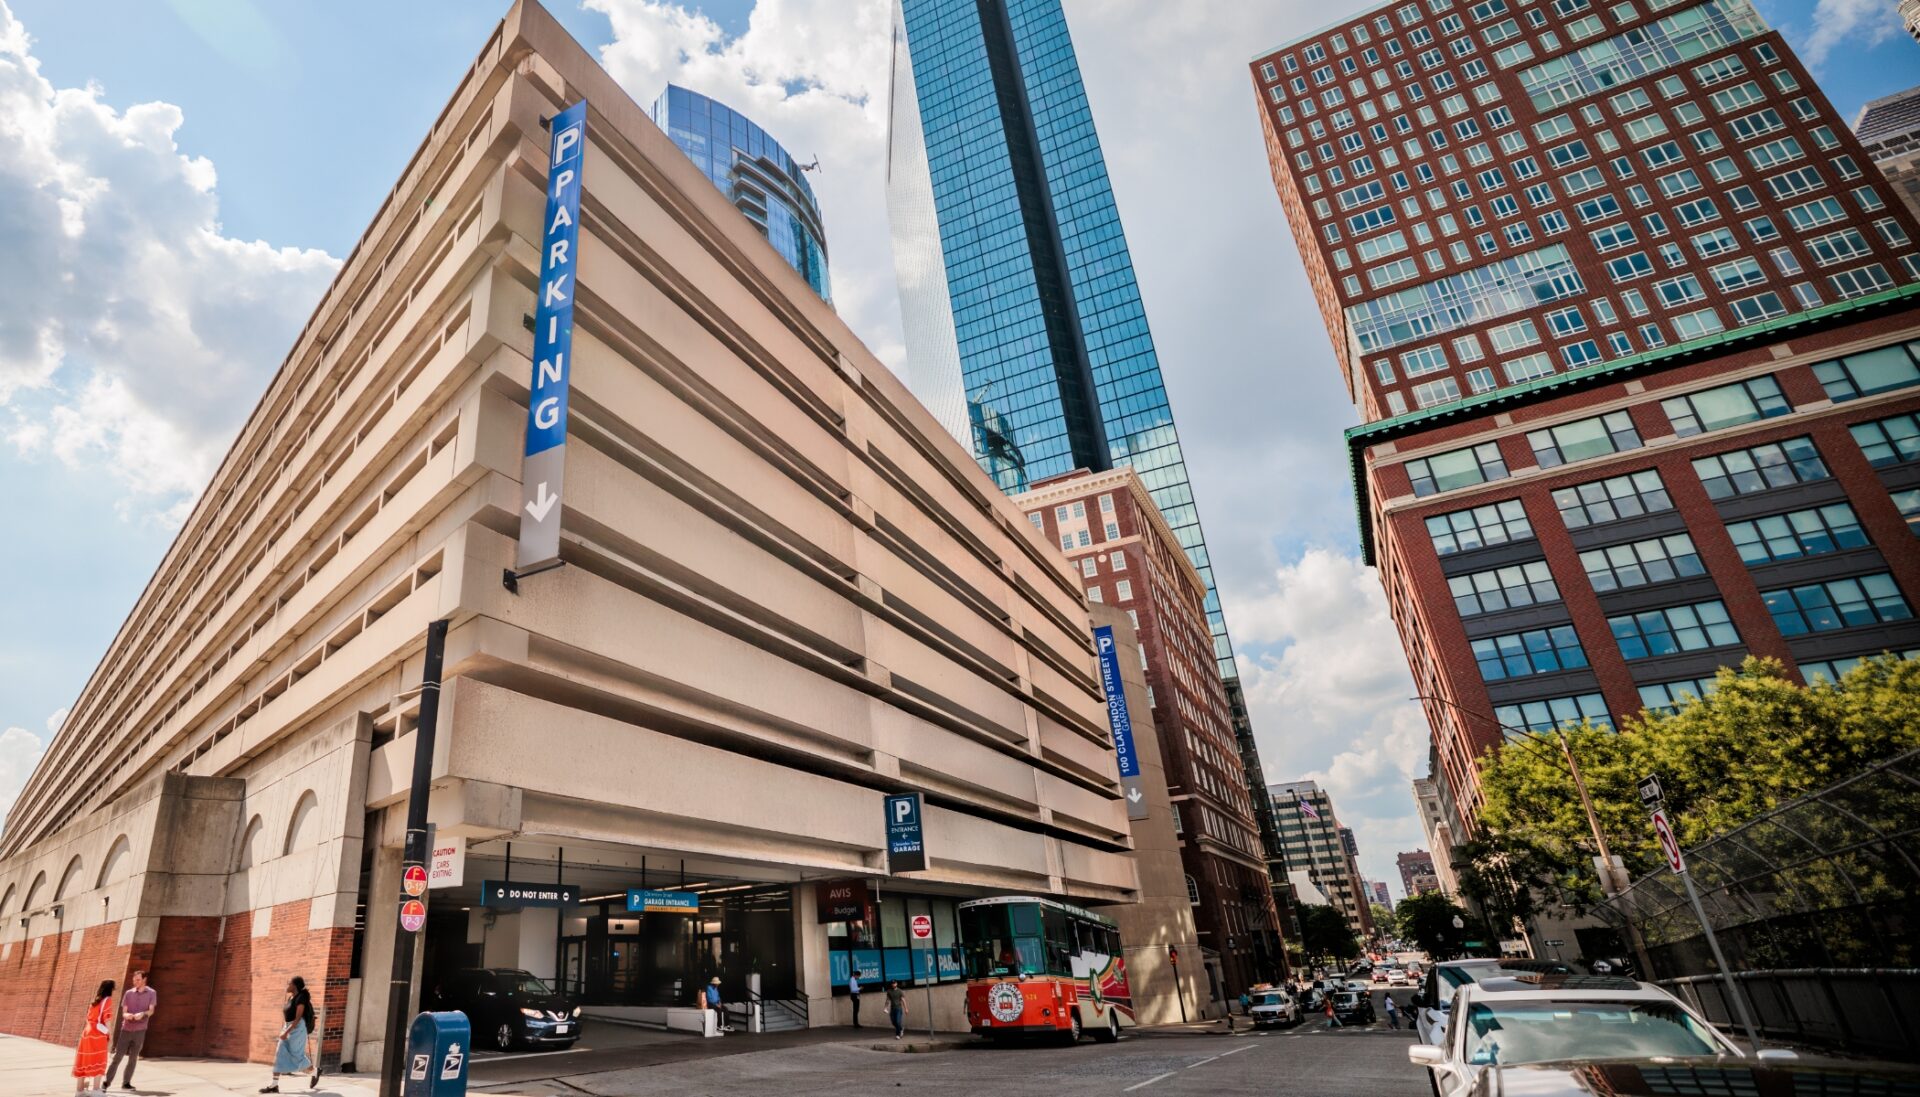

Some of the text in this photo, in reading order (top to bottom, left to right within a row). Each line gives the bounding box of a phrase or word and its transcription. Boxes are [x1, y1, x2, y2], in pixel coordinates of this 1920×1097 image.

[555, 127, 579, 165] P
[535, 169, 574, 430] PARKING
[1099, 637, 1112, 653] P
[1101, 657, 1130, 773] 100 CLARENDON STREET
[1116, 693, 1130, 732] GARAGE
[895, 800, 911, 823] P
[891, 825, 919, 833] ENTRANCE
[432, 847, 456, 857] CAUTION
[893, 845, 920, 853] GARAGE
[436, 860, 450, 869] CARS
[412, 868, 421, 880] F
[432, 869, 452, 878] EXITING
[509, 890, 558, 900] DO NOT ENTER
[829, 888, 852, 899] AVIS
[633, 894, 640, 906] P
[644, 898, 690, 907] GARAGE ENTRANCE
[409, 902, 418, 914] F
[834, 906, 857, 915] Budget
[926, 953, 934, 974] P
